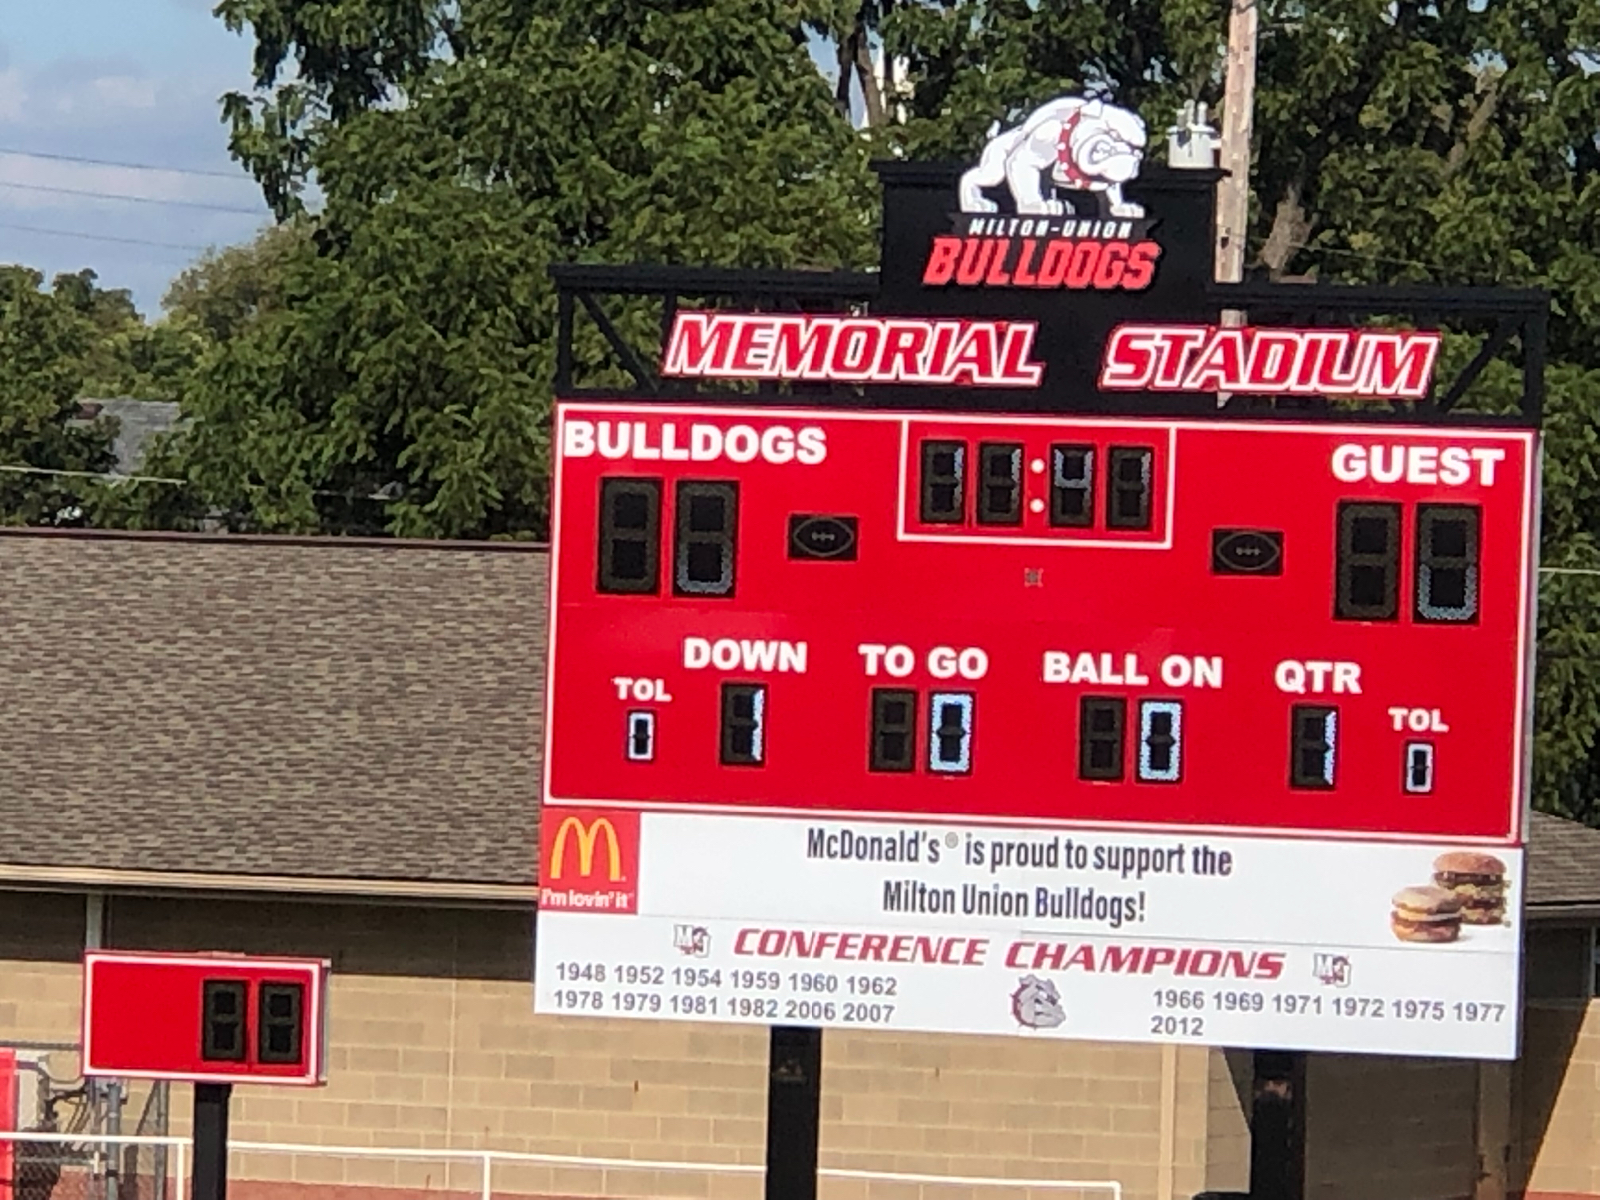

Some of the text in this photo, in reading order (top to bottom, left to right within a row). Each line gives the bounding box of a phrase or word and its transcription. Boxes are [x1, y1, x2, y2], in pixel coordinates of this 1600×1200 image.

[968, 217, 1133, 238] MILTON-UNION
[922, 236, 1162, 291] BULLDOGS
[664, 313, 1439, 397] MEMORIAL STADIUM
[563, 420, 827, 465] BULLDOGS
[1331, 443, 1505, 486] GUEST
[683, 637, 807, 673] DOWN
[858, 643, 989, 680] TO GO
[1042, 650, 1223, 689] BALL ON
[613, 677, 672, 702] TOL
[1275, 660, 1362, 695] QTR
[627, 712, 654, 761] 0
[929, 691, 973, 773] 0
[1388, 706, 1449, 733] TOL
[1138, 701, 1182, 781] 0
[1406, 743, 1433, 793] 0
[806, 827, 1233, 881] McDonald's is proud to support the
[882, 880, 1146, 929] Milton Union Bulldogs!
[733, 928, 1287, 980] CONFERENCE CHAMPIONS
[556, 962, 898, 996] 1948 1952 1954 1959 1960 1962
[554, 990, 896, 1023] 1978 1979 1981 1982 2006 2007
[1150, 1015, 1204, 1037] 2012
[1153, 989, 1505, 1023] 1966 1969 1971 1972 1975 1977
